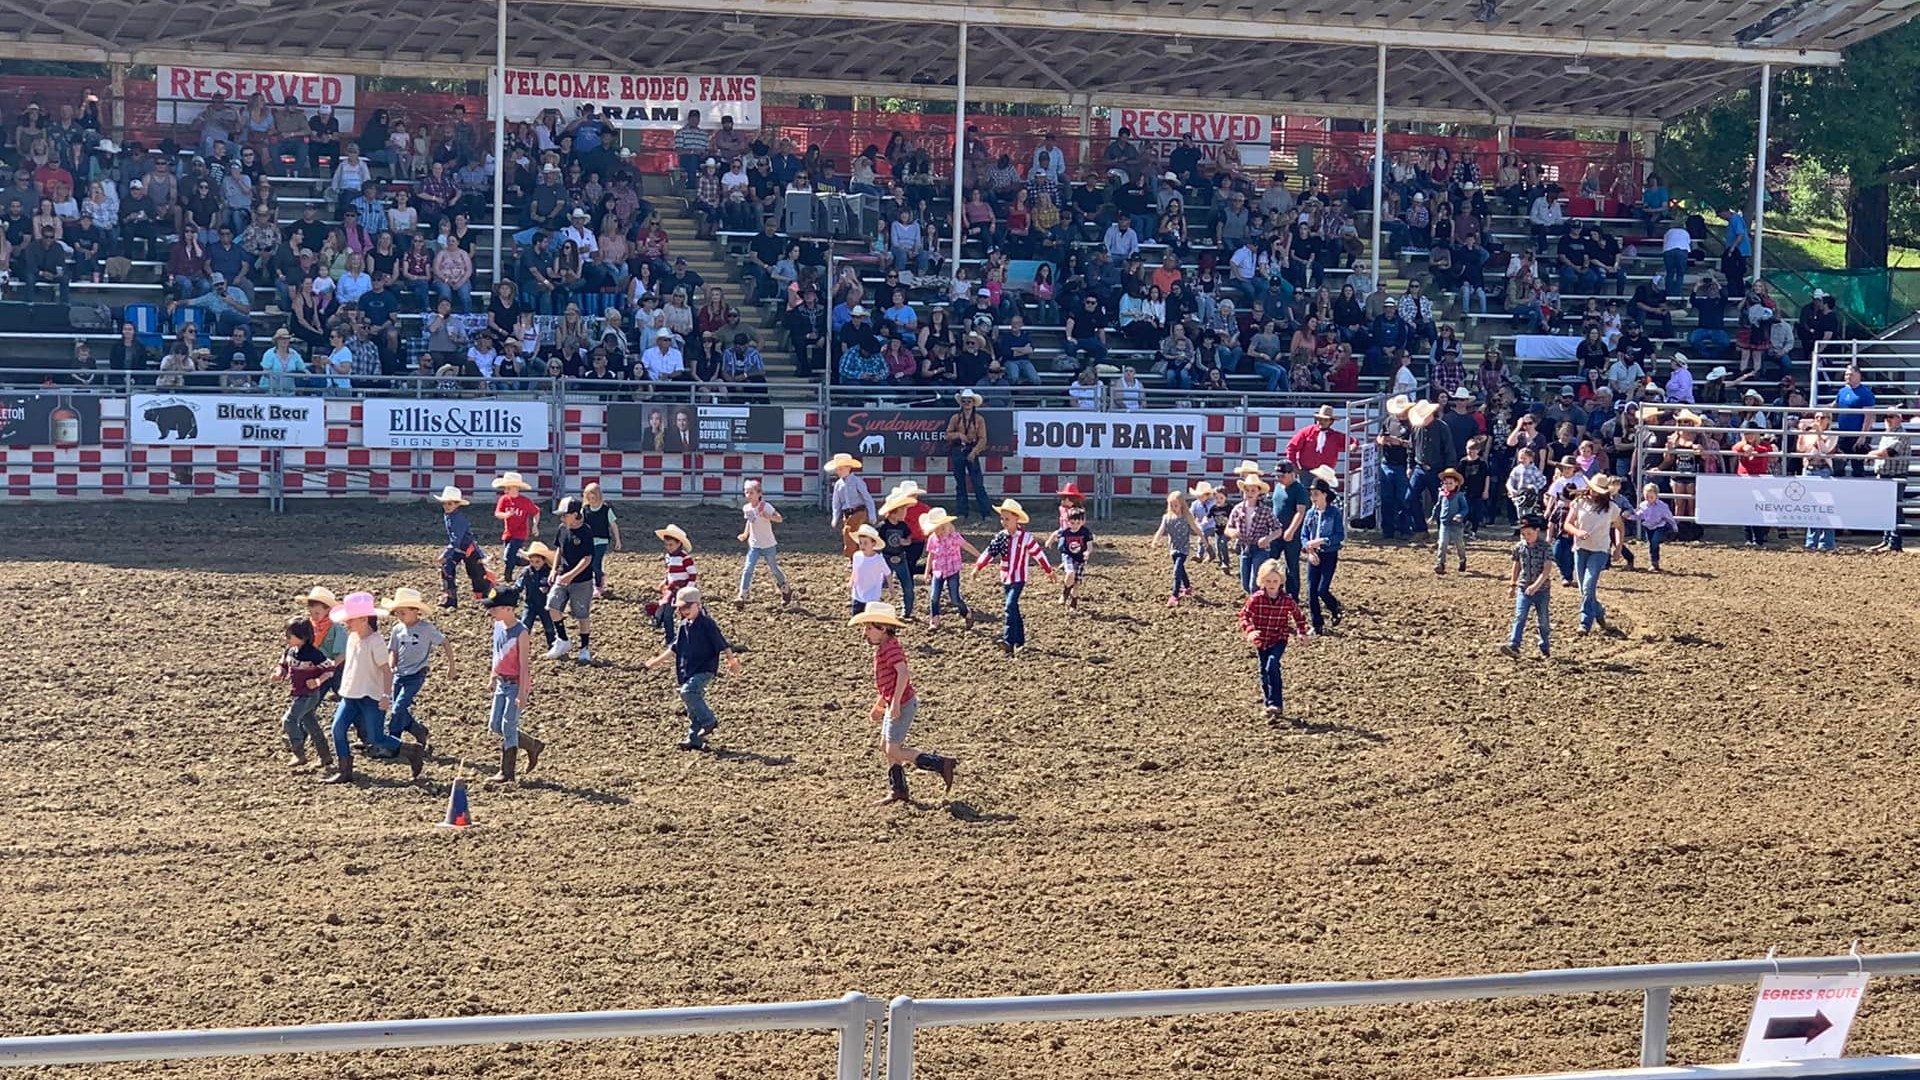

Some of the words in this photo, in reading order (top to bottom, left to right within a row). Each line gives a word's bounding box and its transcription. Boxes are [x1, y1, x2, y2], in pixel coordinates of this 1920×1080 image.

[170, 67, 342, 105] RESERVED
[620, 75, 689, 101] RODEO
[699, 77, 756, 101] FANS
[601, 106, 679, 121] RAM
[1121, 109, 1261, 142] RESERVED
[217, 404, 264, 420] Black
[269, 405, 309, 421] Bear
[389, 407, 522, 435] Ellis&Ellis
[699, 420, 730, 430] CRIMINAL
[843, 412, 945, 437] Sundowner
[241, 424, 287, 440] Diner
[699, 430, 727, 440] DEFENSE
[1024, 421, 1106, 449] BOOT
[1112, 422, 1195, 450] BARN
[390, 438, 432, 447] SIGN
[441, 439, 520, 448] SYSTEMS
[1754, 502, 1835, 514] NEWCASTLE
[1761, 988, 1813, 1000] EGRESS
[1817, 987, 1860, 999] ROUTE
